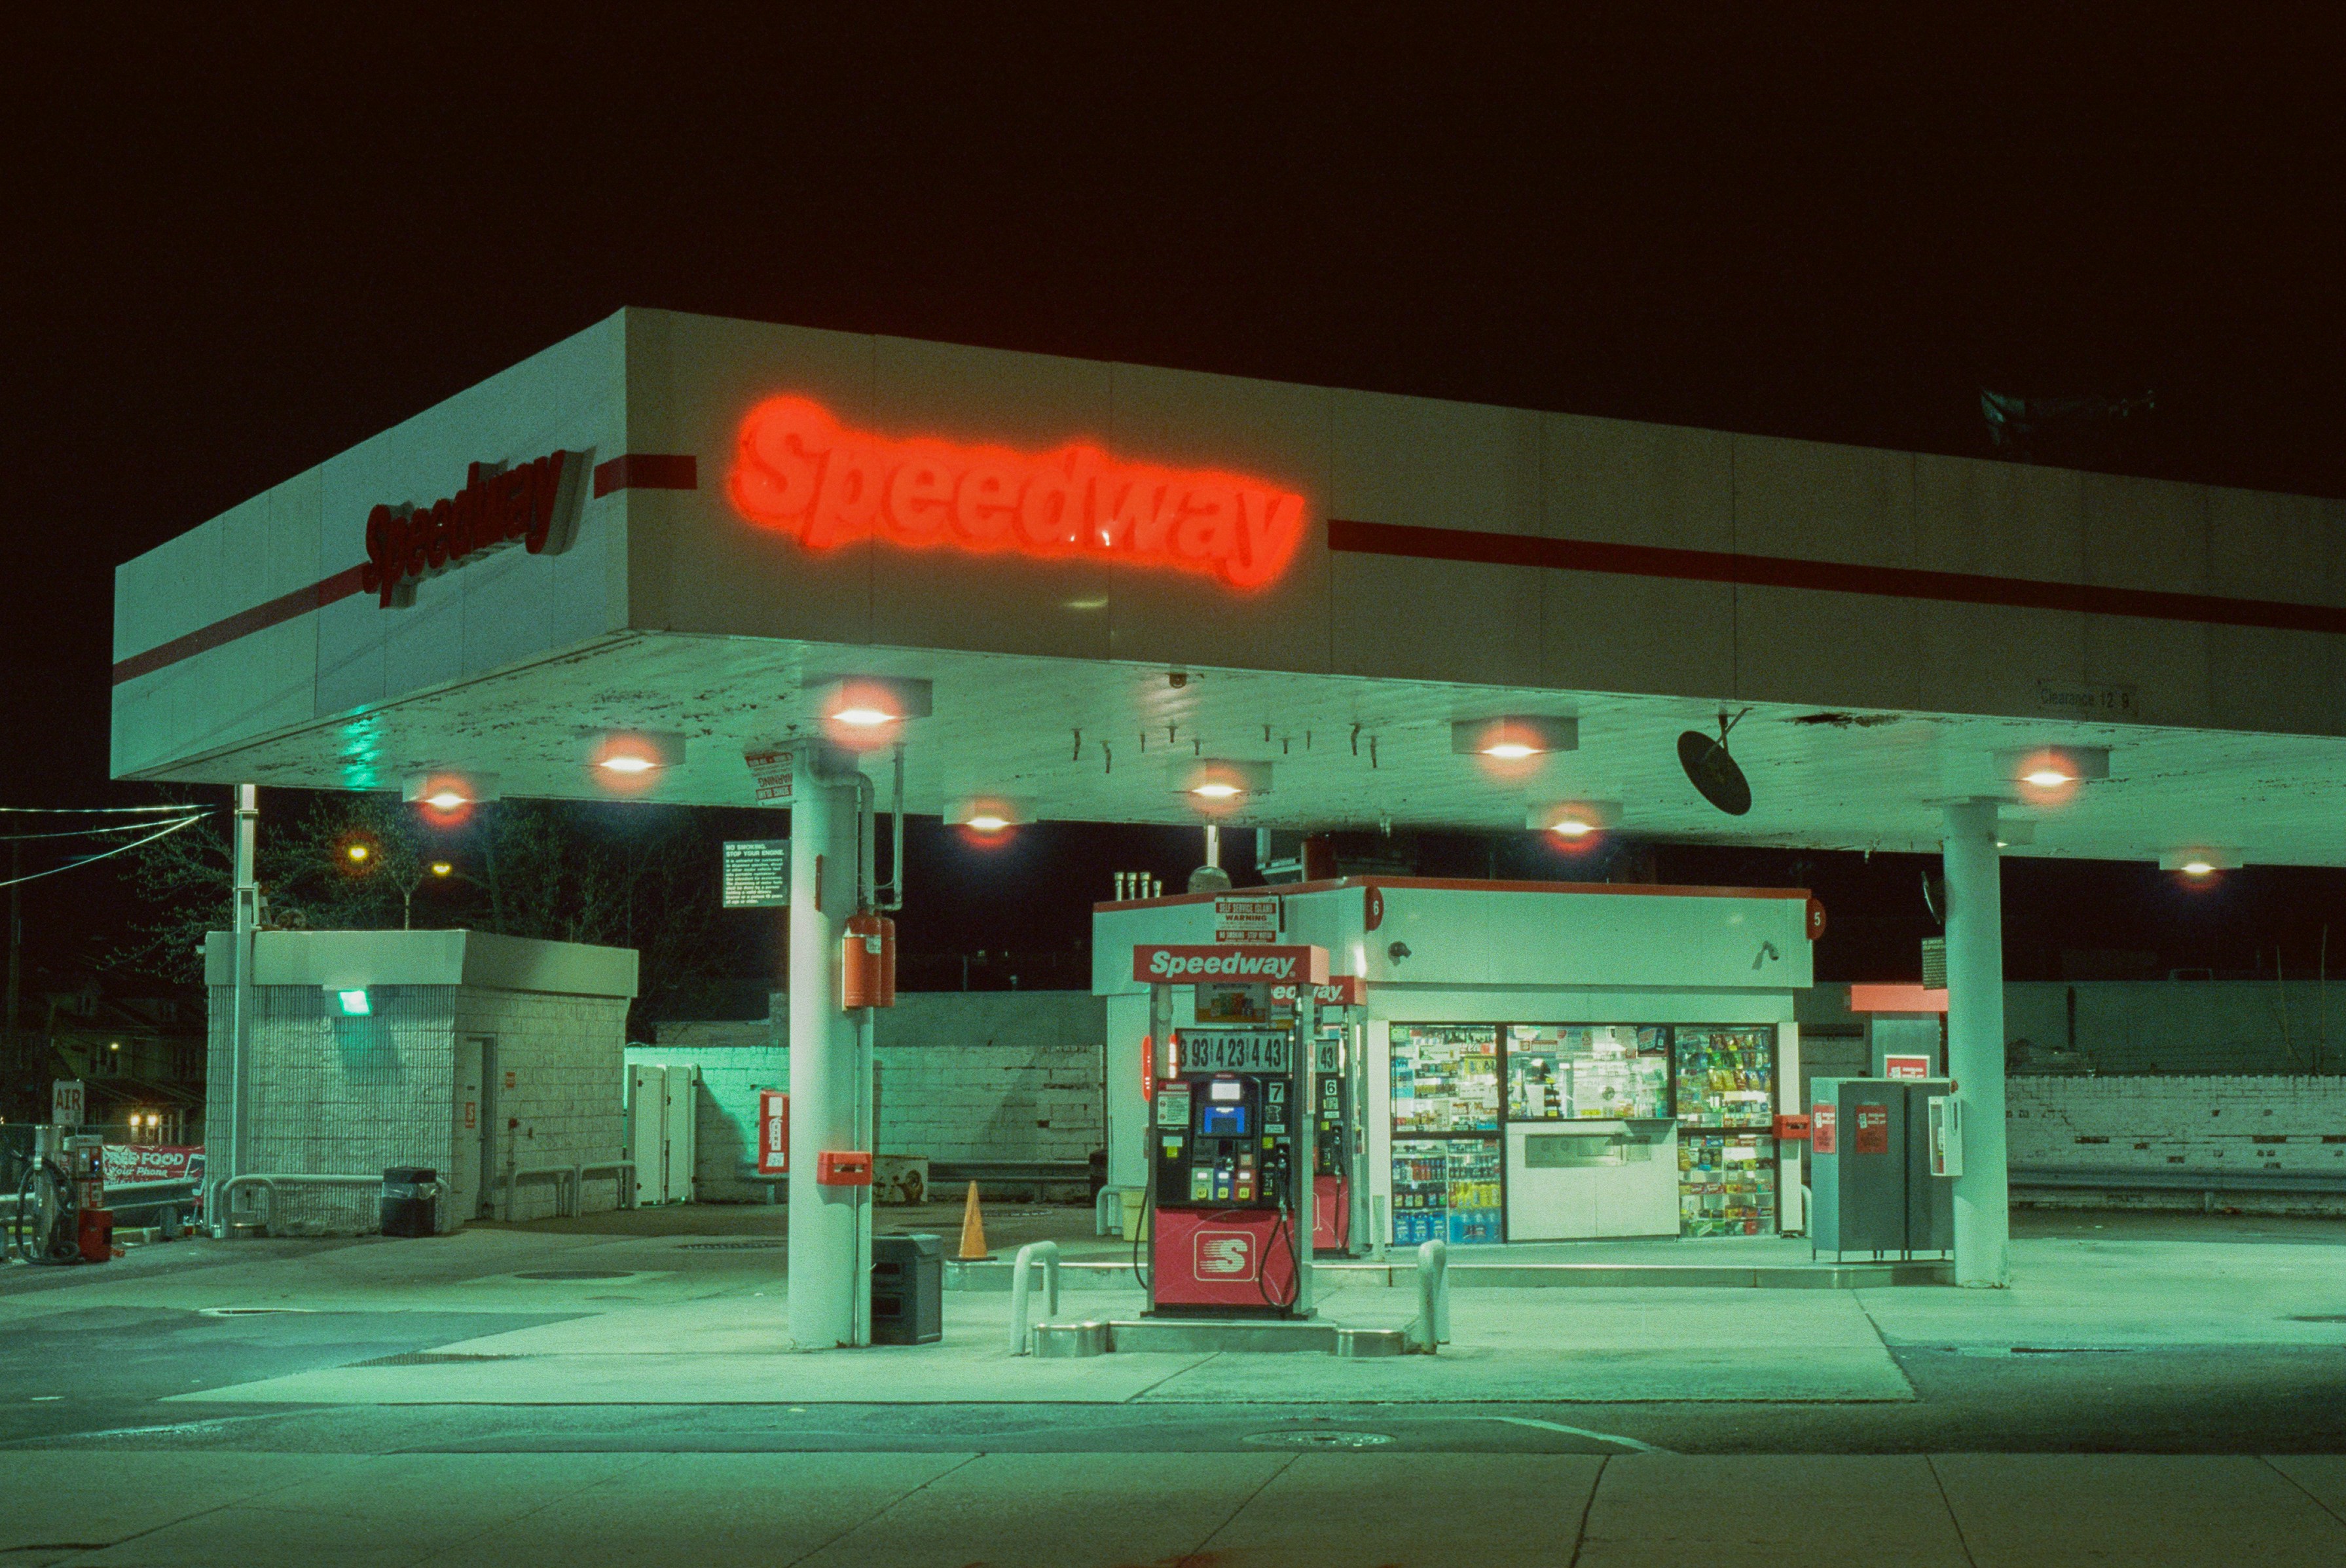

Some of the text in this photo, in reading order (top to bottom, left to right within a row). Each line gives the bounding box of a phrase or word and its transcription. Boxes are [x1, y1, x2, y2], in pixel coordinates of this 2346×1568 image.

[735, 399, 1304, 587] Speedway
[1373, 900, 1380, 916] 6
[1814, 911, 1821, 926] 5
[1150, 951, 1296, 979] Speedway
[1271, 1084, 1283, 1101] 7
[1327, 1082, 1336, 1094] 6
[55, 1089, 81, 1110] AIR
[141, 1152, 184, 1166] FOOD
[111, 1166, 134, 1176] Your
[136, 1167, 168, 1177] Phone
